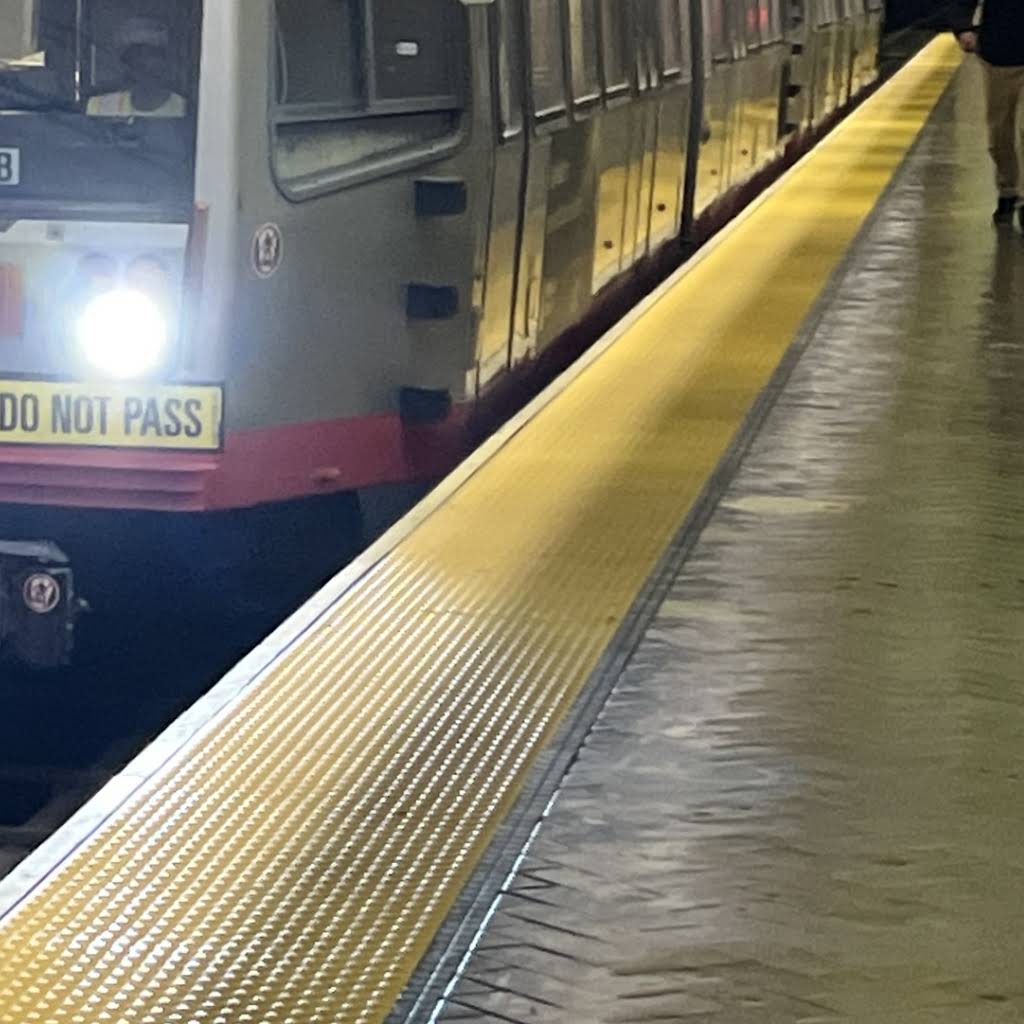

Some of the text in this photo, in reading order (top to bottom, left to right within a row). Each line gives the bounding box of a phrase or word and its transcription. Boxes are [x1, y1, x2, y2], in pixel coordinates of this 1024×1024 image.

[0, 393, 203, 438] DO NOT PASS
